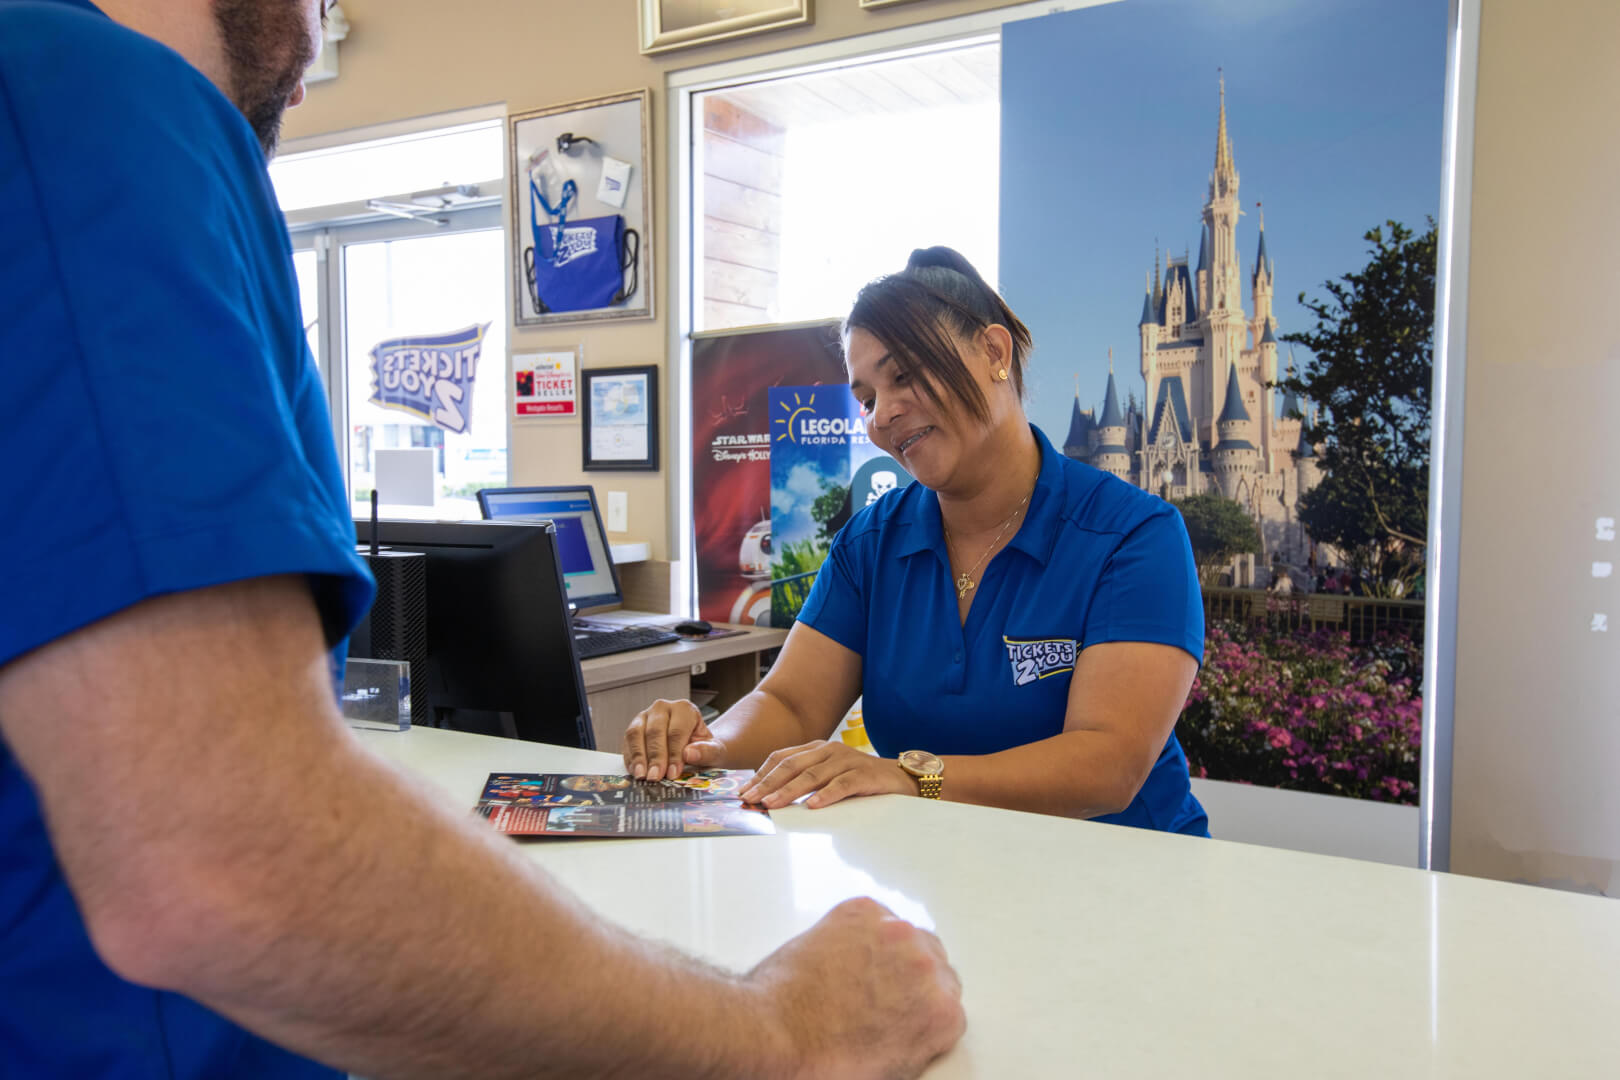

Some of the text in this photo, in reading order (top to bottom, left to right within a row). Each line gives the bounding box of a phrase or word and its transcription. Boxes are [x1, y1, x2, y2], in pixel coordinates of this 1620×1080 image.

[536, 379, 573, 390] TICKET
[801, 417, 868, 436] LEGOLA
[711, 434, 748, 446] STAR
[801, 436, 846, 445] FLORIDA
[1005, 642, 1073, 660] TICKETS
